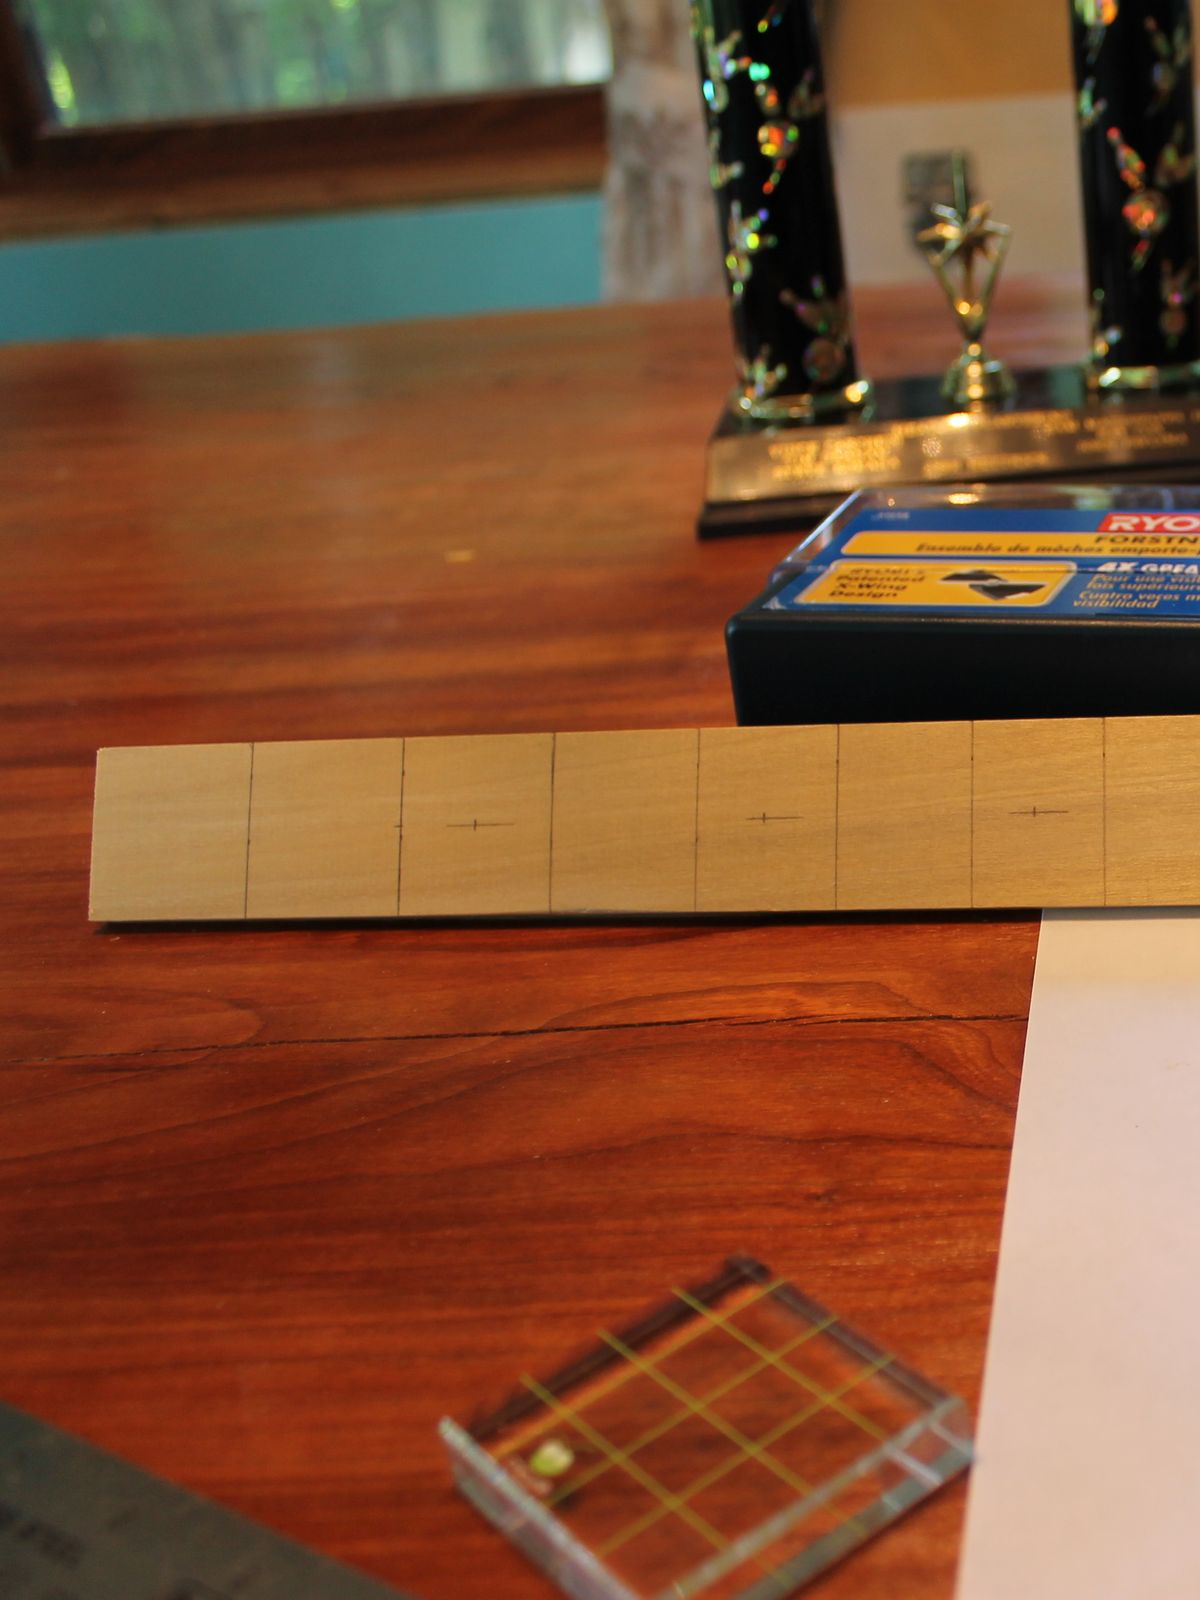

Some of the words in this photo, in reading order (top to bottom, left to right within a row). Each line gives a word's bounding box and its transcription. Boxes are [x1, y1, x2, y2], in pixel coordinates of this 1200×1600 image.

[916, 543, 1001, 552] Ensemble
[1007, 543, 1029, 552] de
[1097, 561, 1137, 572] 4X
[1092, 574, 1132, 582] Pour
[1079, 591, 1132, 600] Cuatro
[1138, 593, 1180, 601] veces
[1073, 600, 1158, 608] visibilidad
